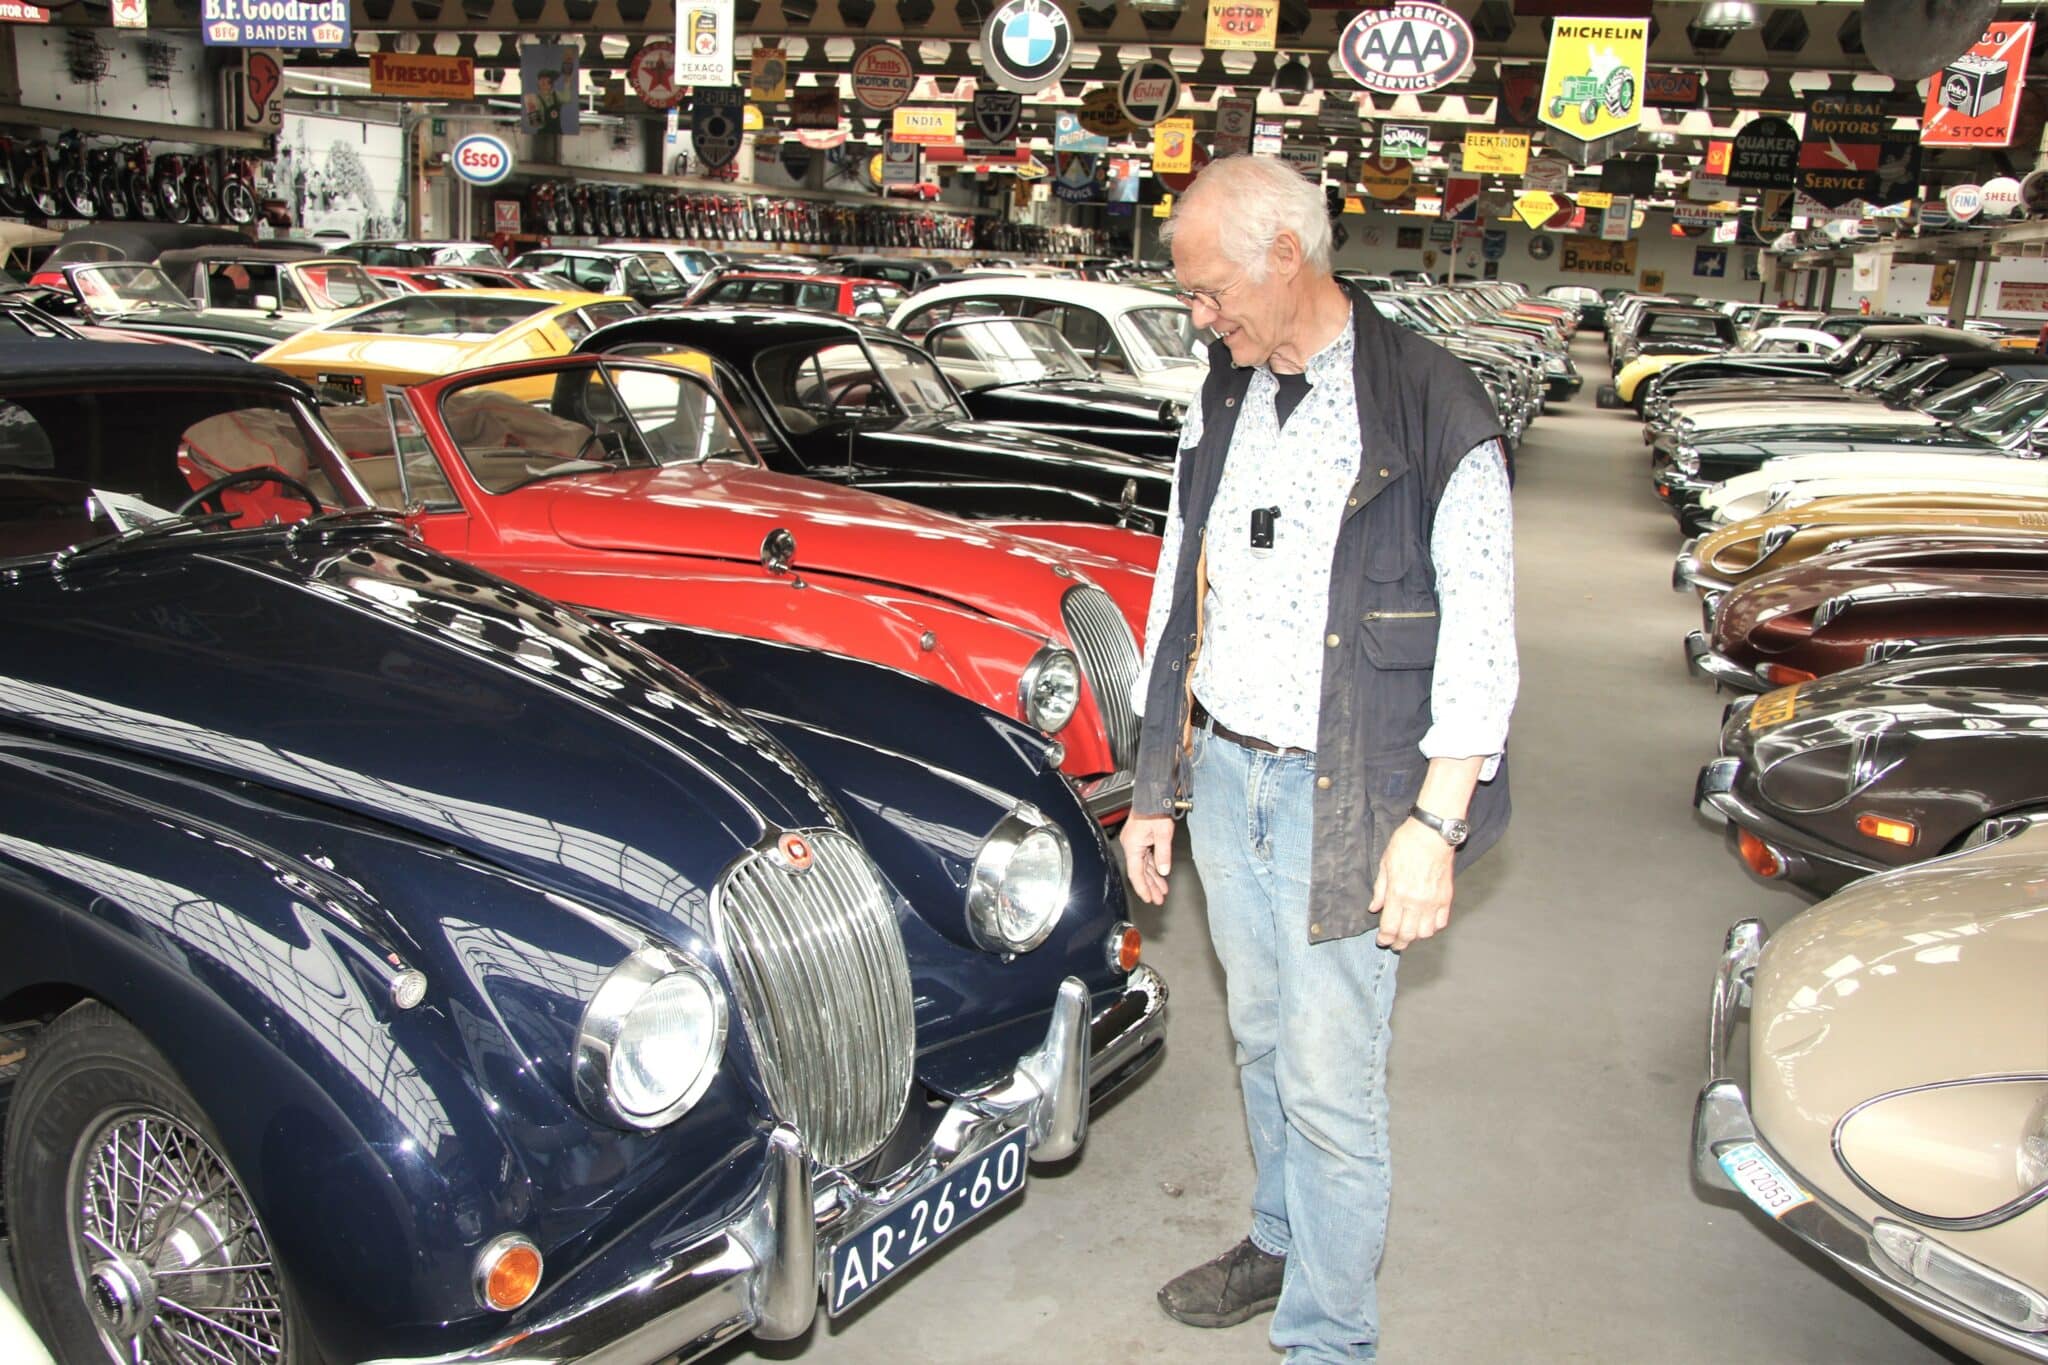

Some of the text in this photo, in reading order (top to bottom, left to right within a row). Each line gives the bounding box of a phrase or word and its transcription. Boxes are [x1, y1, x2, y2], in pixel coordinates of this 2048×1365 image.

[24, 6, 40, 18] OIL
[243, 0, 346, 21] Goodrich
[999, 0, 1065, 27] BMW
[1213, 6, 1273, 17] VICTORY
[1226, 20, 1256, 32] OIL
[1356, 7, 1456, 32] EMERGENCY
[215, 25, 339, 41] BFG BANDEN BFG
[1557, 26, 1644, 39] MICHELIN
[1361, 21, 1448, 73] AAA
[371, 54, 470, 85] TYRESOLES
[682, 63, 724, 73] TEXACO
[856, 76, 907, 88] MOTOR OIL
[1365, 71, 1437, 88] SERVICE
[1132, 82, 1167, 102] Castrol
[1948, 83, 1967, 97] Delco
[1811, 100, 1883, 115] GENERAL
[906, 115, 943, 127] INDIA
[1811, 118, 1879, 135] MOTORS
[1951, 126, 2007, 138] STOCK
[1467, 135, 1526, 149] ELEKTRION
[1737, 136, 1796, 151] QUAKER
[1281, 151, 1316, 162] Mobil
[1739, 152, 1790, 167] STATE
[1732, 171, 1770, 180] MOTOR
[1804, 172, 1865, 190] SERVICE
[1954, 195, 1978, 207] FINA
[1985, 192, 2018, 202] SHELL
[836, 1142, 1019, 1308] AR-26-60
